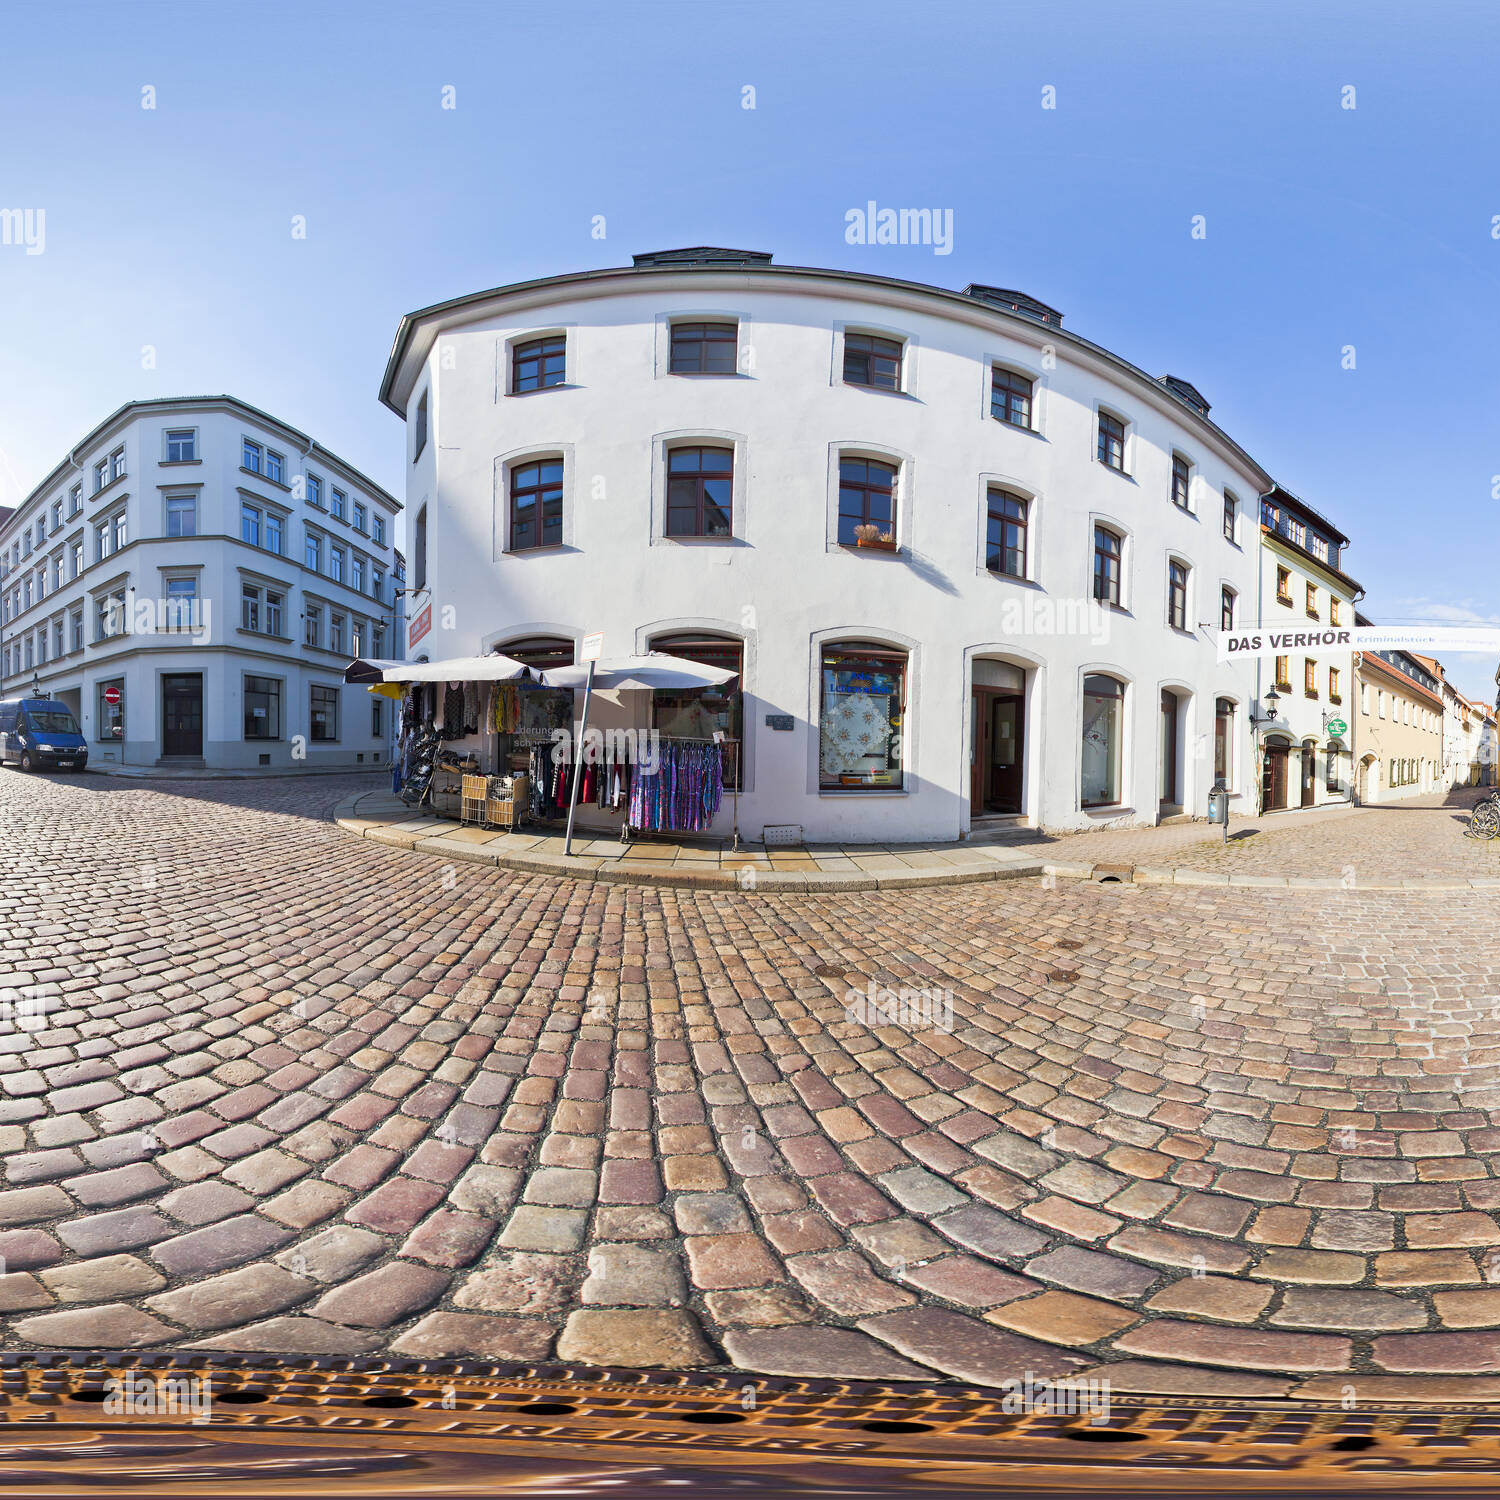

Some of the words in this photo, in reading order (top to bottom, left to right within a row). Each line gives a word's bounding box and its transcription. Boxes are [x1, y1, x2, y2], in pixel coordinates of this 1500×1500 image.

[1228, 636, 1262, 652] DAS
[1269, 630, 1351, 648] VERHÖR
[851, 671, 870, 681] Asia
[519, 727, 559, 737] derungs
[196, 1413, 421, 1429] STADT
[437, 1421, 888, 1452] FREIBERG
